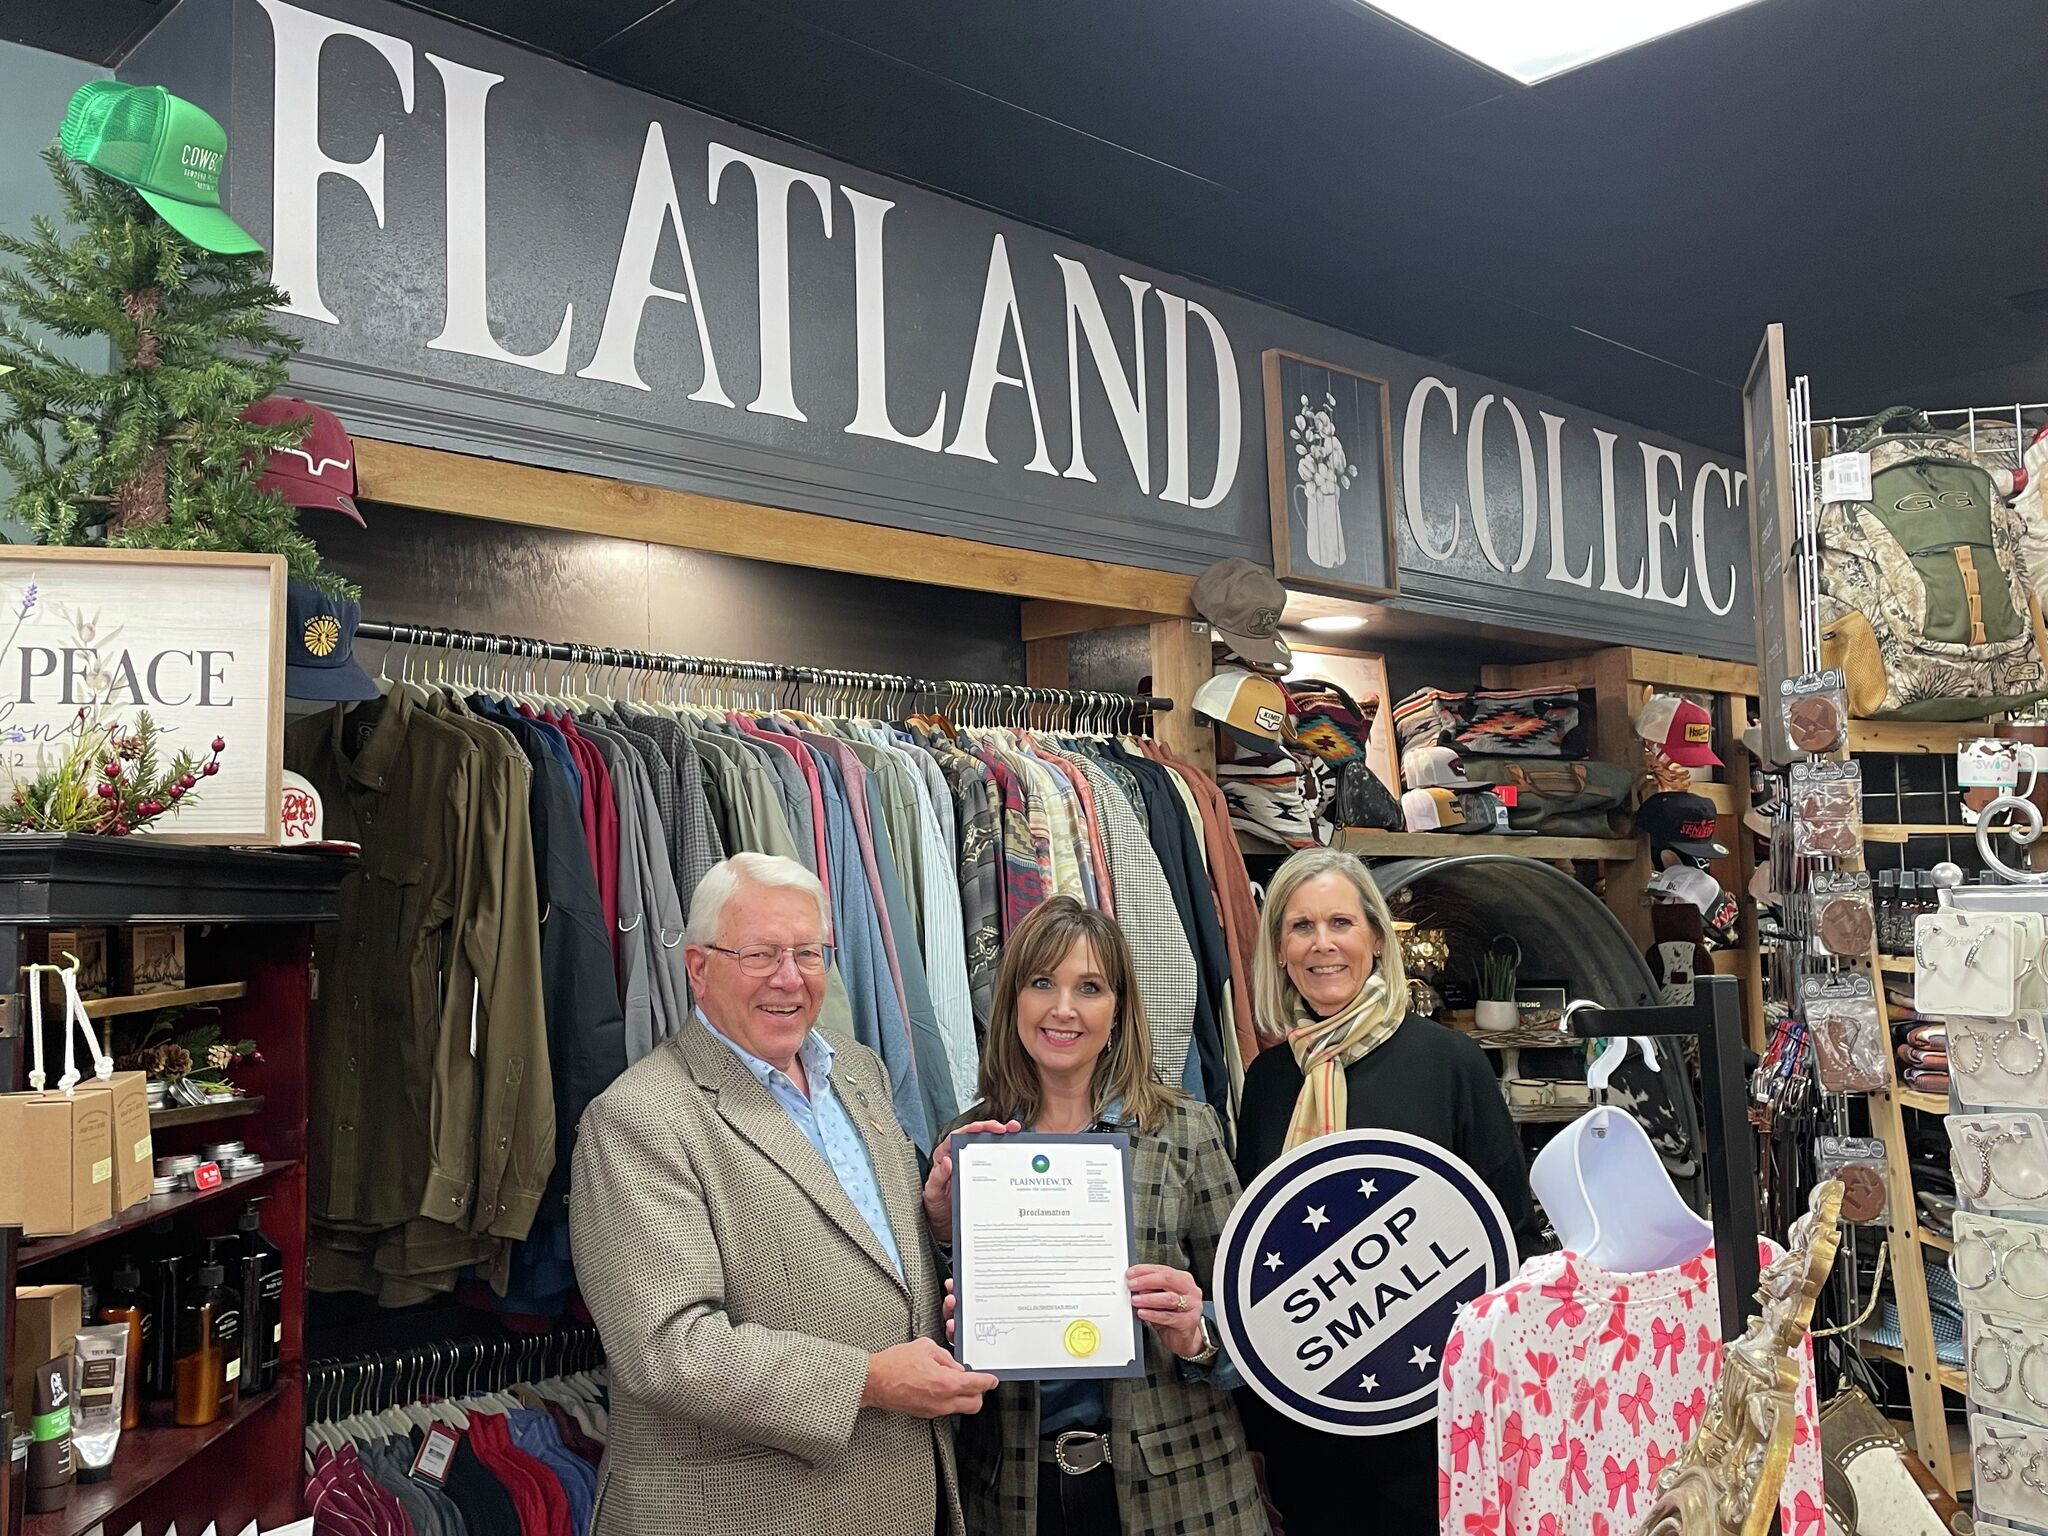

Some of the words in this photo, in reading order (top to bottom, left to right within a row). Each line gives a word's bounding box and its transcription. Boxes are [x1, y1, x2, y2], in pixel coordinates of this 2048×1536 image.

[256, 0, 1242, 510] FLATLAND
[1402, 376, 1748, 616] COLLEC
[1894, 490, 1976, 513] GG
[16, 646, 234, 707] PEACE
[1018, 1208, 1071, 1218] Proclamation
[1283, 1206, 1418, 1324] SHOP
[1296, 1241, 1471, 1372] SMALL
